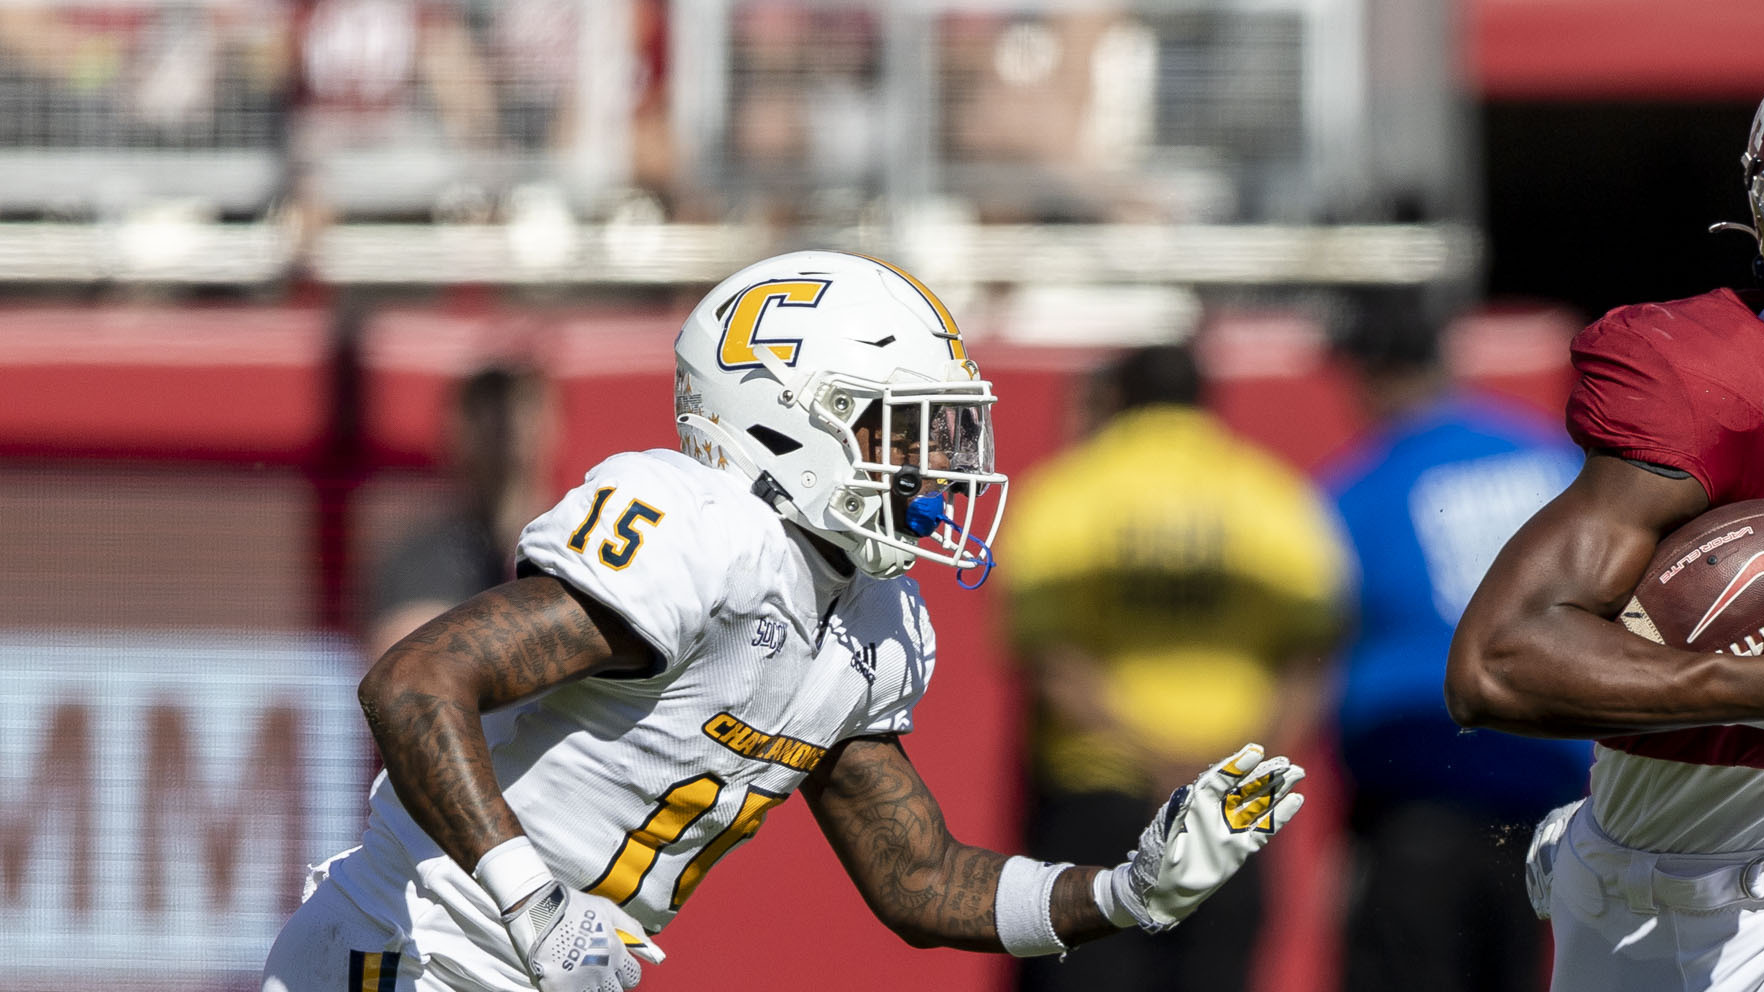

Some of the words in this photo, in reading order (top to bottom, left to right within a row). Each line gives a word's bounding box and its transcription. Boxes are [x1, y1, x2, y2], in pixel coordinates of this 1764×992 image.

[717, 279, 833, 371] C
[567, 486, 665, 571] 15
[1699, 526, 1754, 553] VAPOR
[1659, 548, 1702, 584] ELITE
[561, 909, 597, 973] adidas
